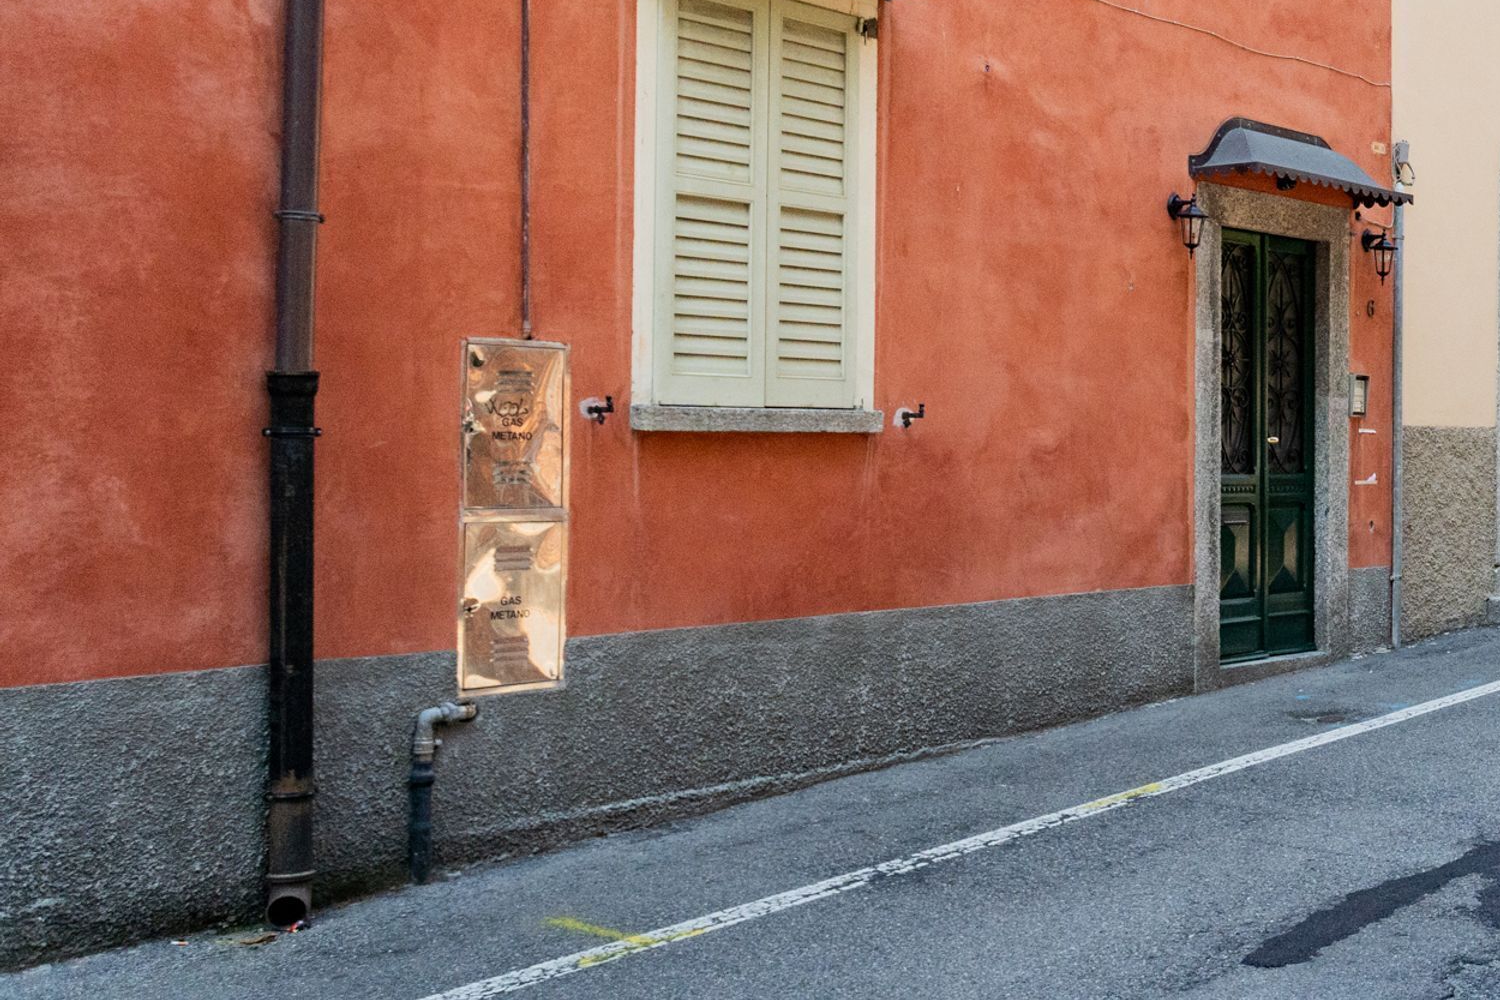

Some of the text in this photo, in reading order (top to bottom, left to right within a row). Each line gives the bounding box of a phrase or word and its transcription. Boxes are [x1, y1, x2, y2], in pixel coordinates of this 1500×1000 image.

[1366, 300, 1375, 318] 6
[502, 417, 524, 427] GAS
[492, 431, 533, 441] METANO
[500, 596, 522, 606] GAS
[490, 609, 530, 620] METANO
